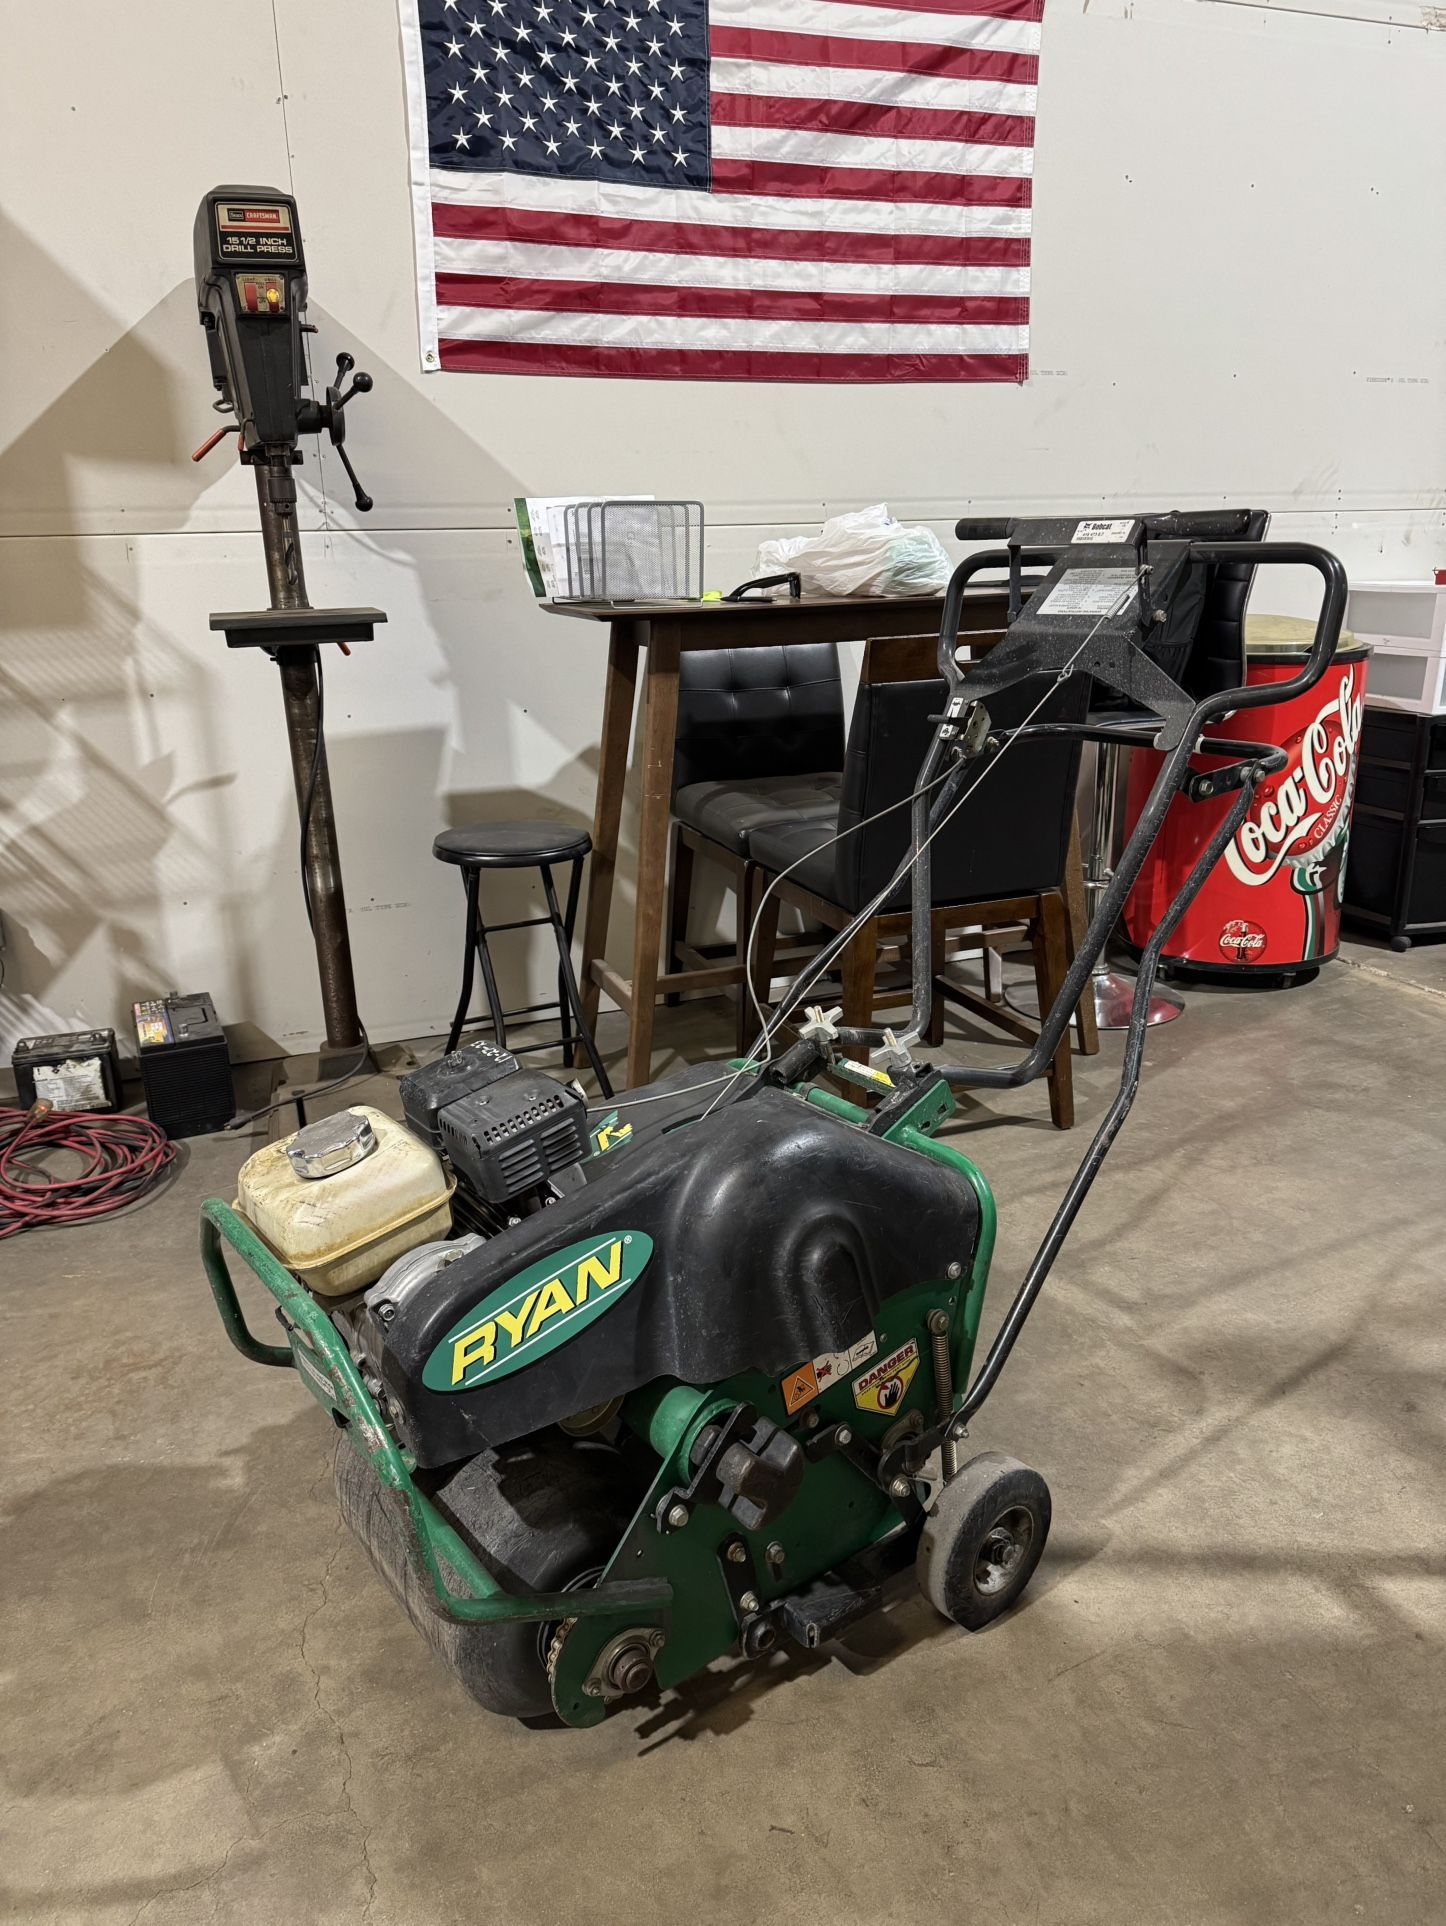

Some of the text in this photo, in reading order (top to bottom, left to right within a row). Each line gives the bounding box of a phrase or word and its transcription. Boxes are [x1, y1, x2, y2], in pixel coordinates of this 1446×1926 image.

[240, 237, 256, 245] 1/2
[1313, 795, 1343, 840] CLASSIC
[451, 1240, 623, 1386] RYAN
[858, 1344, 915, 1391] DANGER
